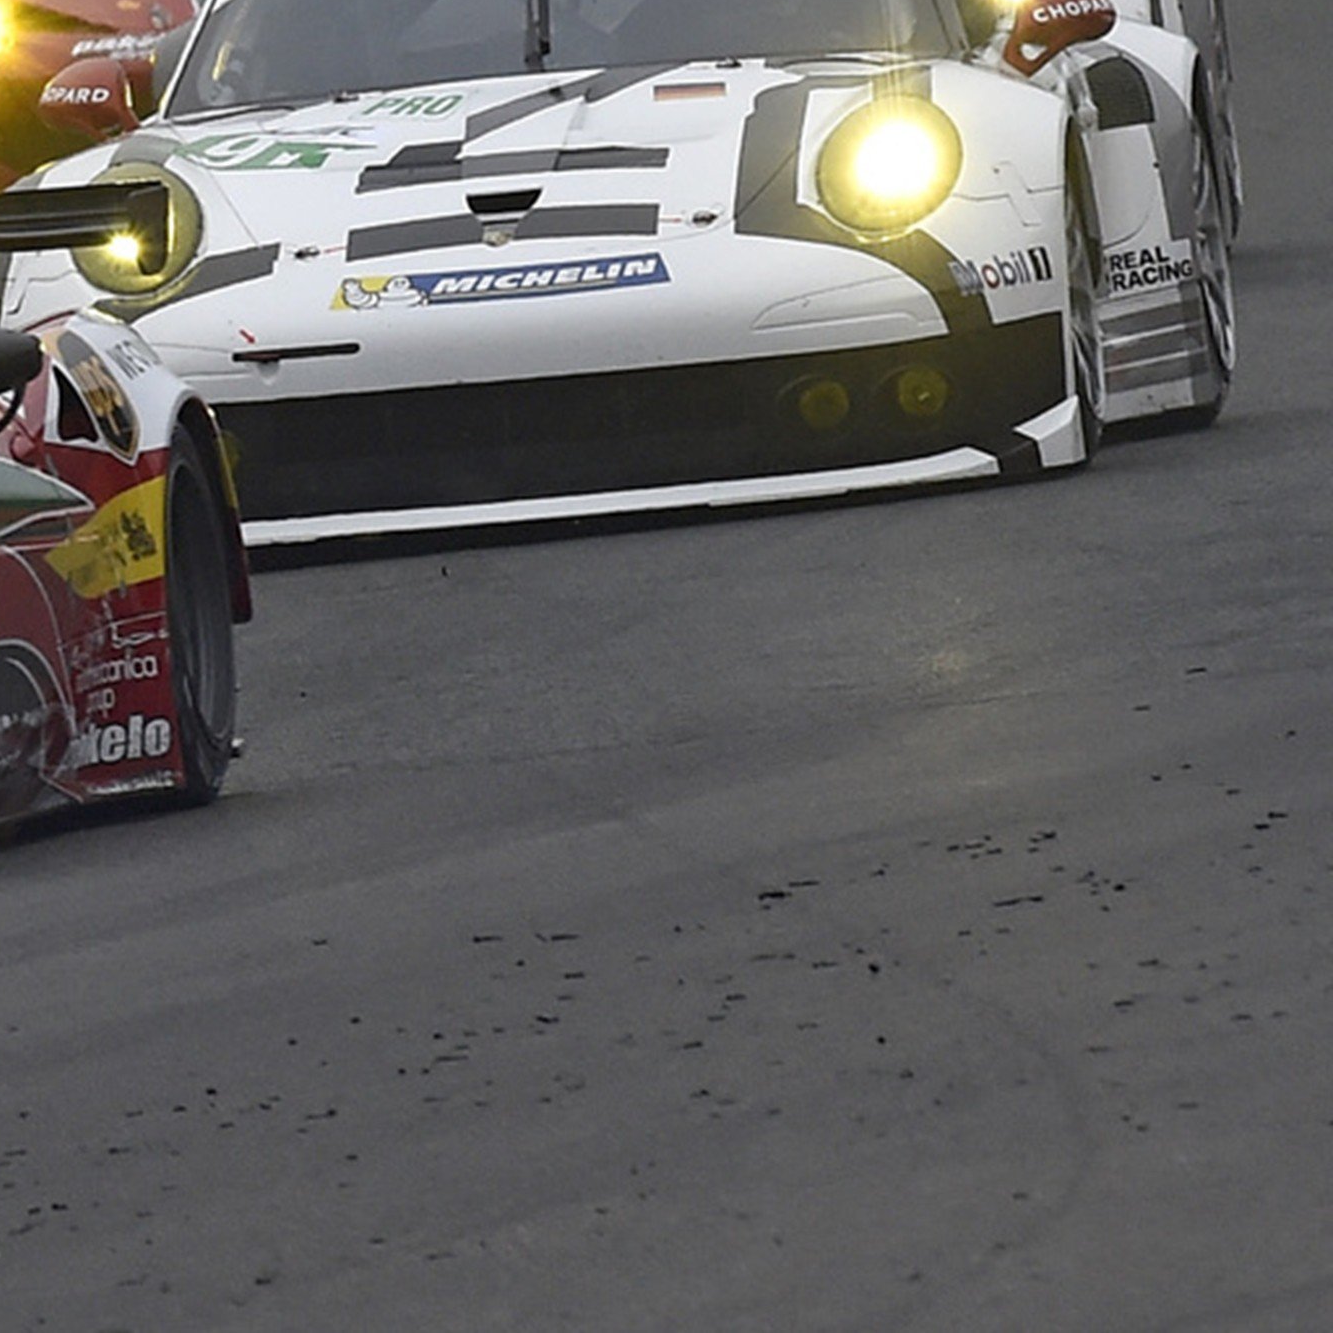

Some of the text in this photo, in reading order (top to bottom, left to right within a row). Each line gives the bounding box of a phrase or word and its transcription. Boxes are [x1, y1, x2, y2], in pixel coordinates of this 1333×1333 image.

[362, 94, 464, 116] PRO
[948, 249, 1031, 296] Mobil
[1109, 246, 1171, 272] REAL
[1111, 259, 1194, 292] RACING
[433, 258, 659, 296] MICHELIN
